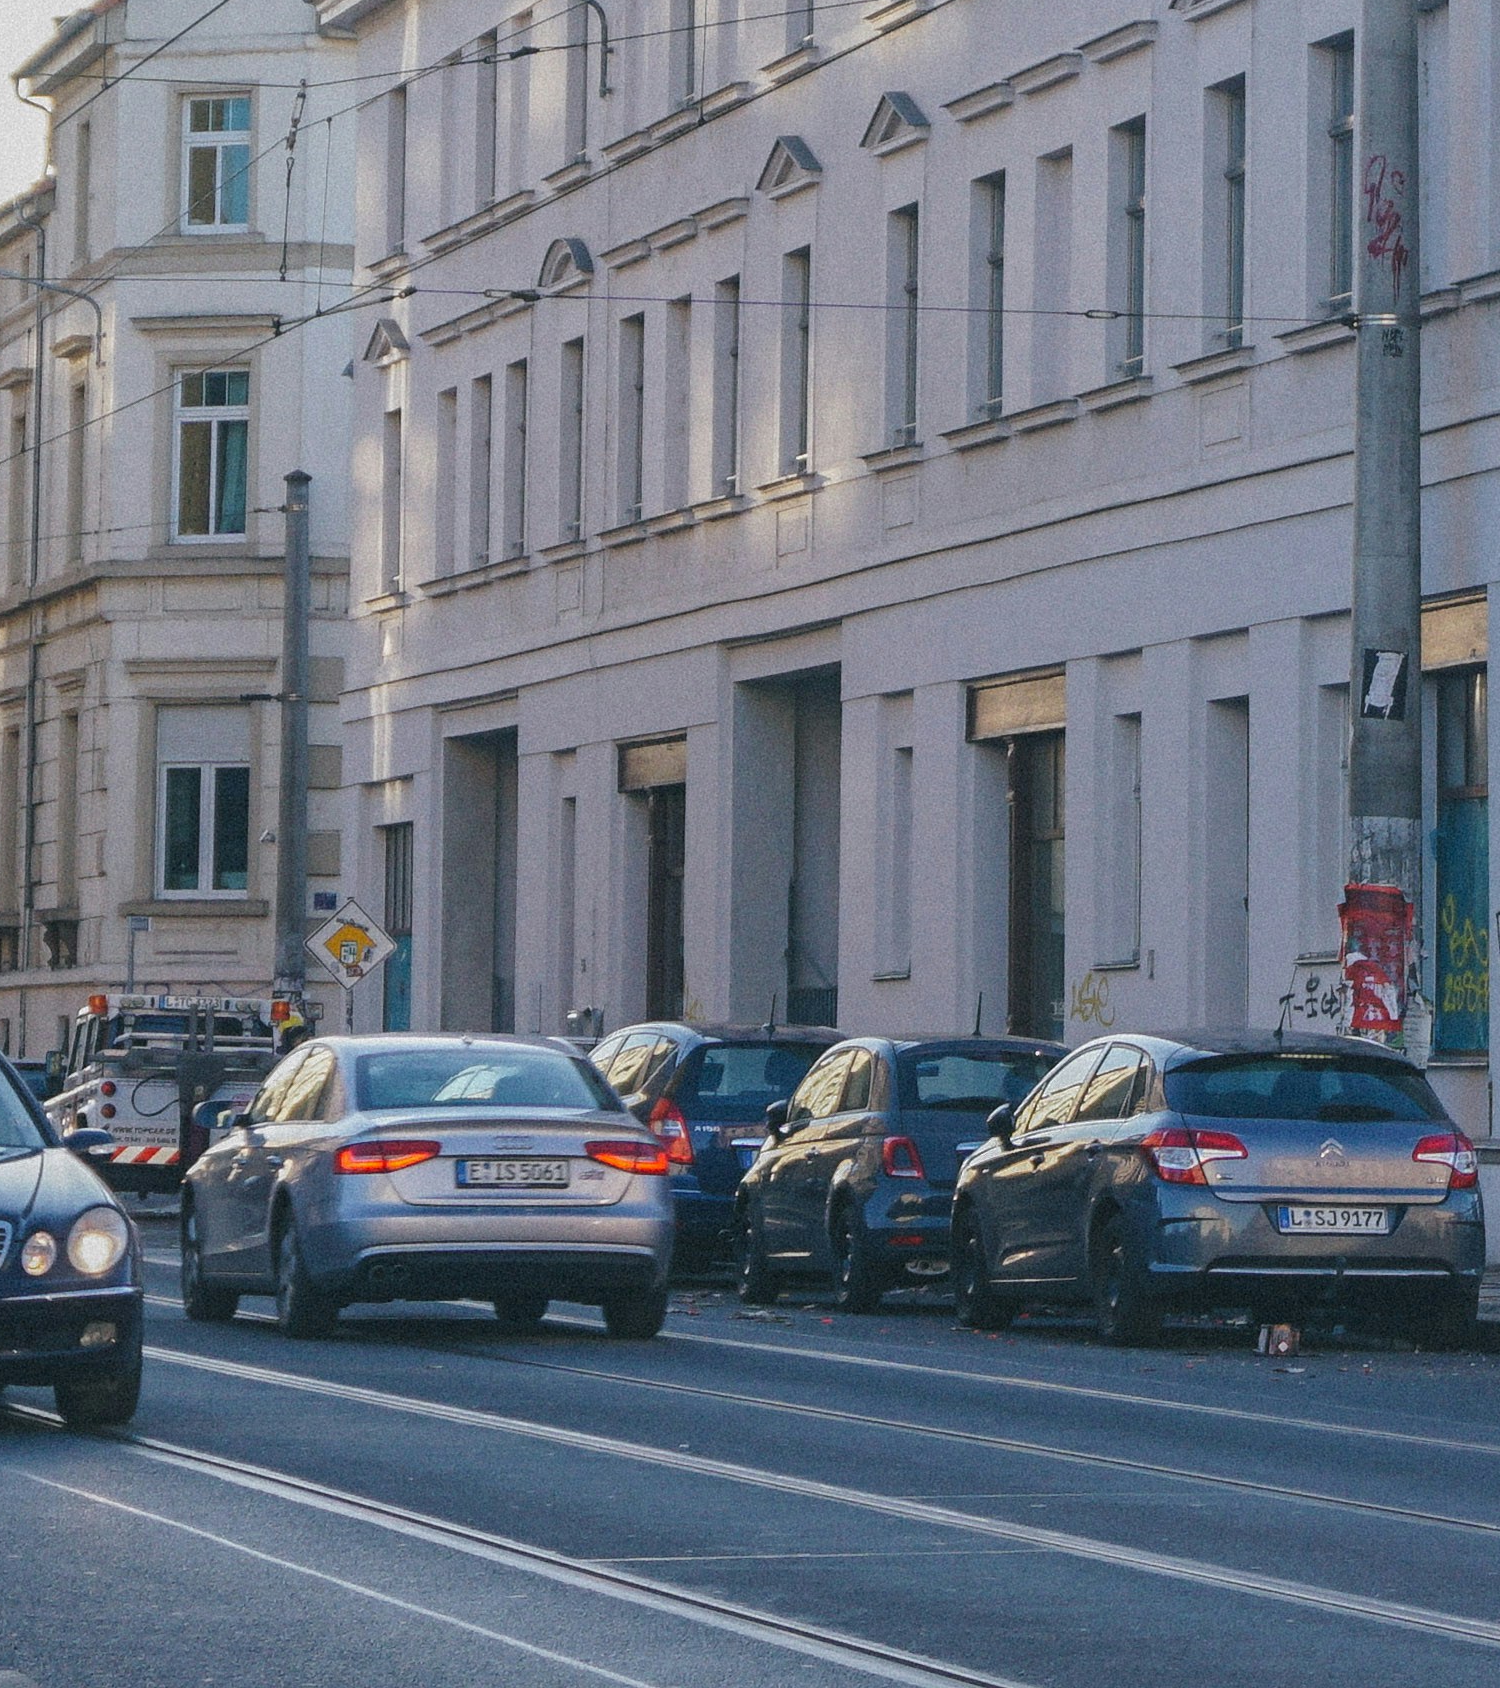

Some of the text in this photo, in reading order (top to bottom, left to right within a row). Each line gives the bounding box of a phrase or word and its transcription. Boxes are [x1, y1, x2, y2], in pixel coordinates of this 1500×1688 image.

[470, 1162, 479, 1181] E
[520, 1162, 566, 1182] 5061
[1290, 1212, 1384, 1227] L SJ 9177
